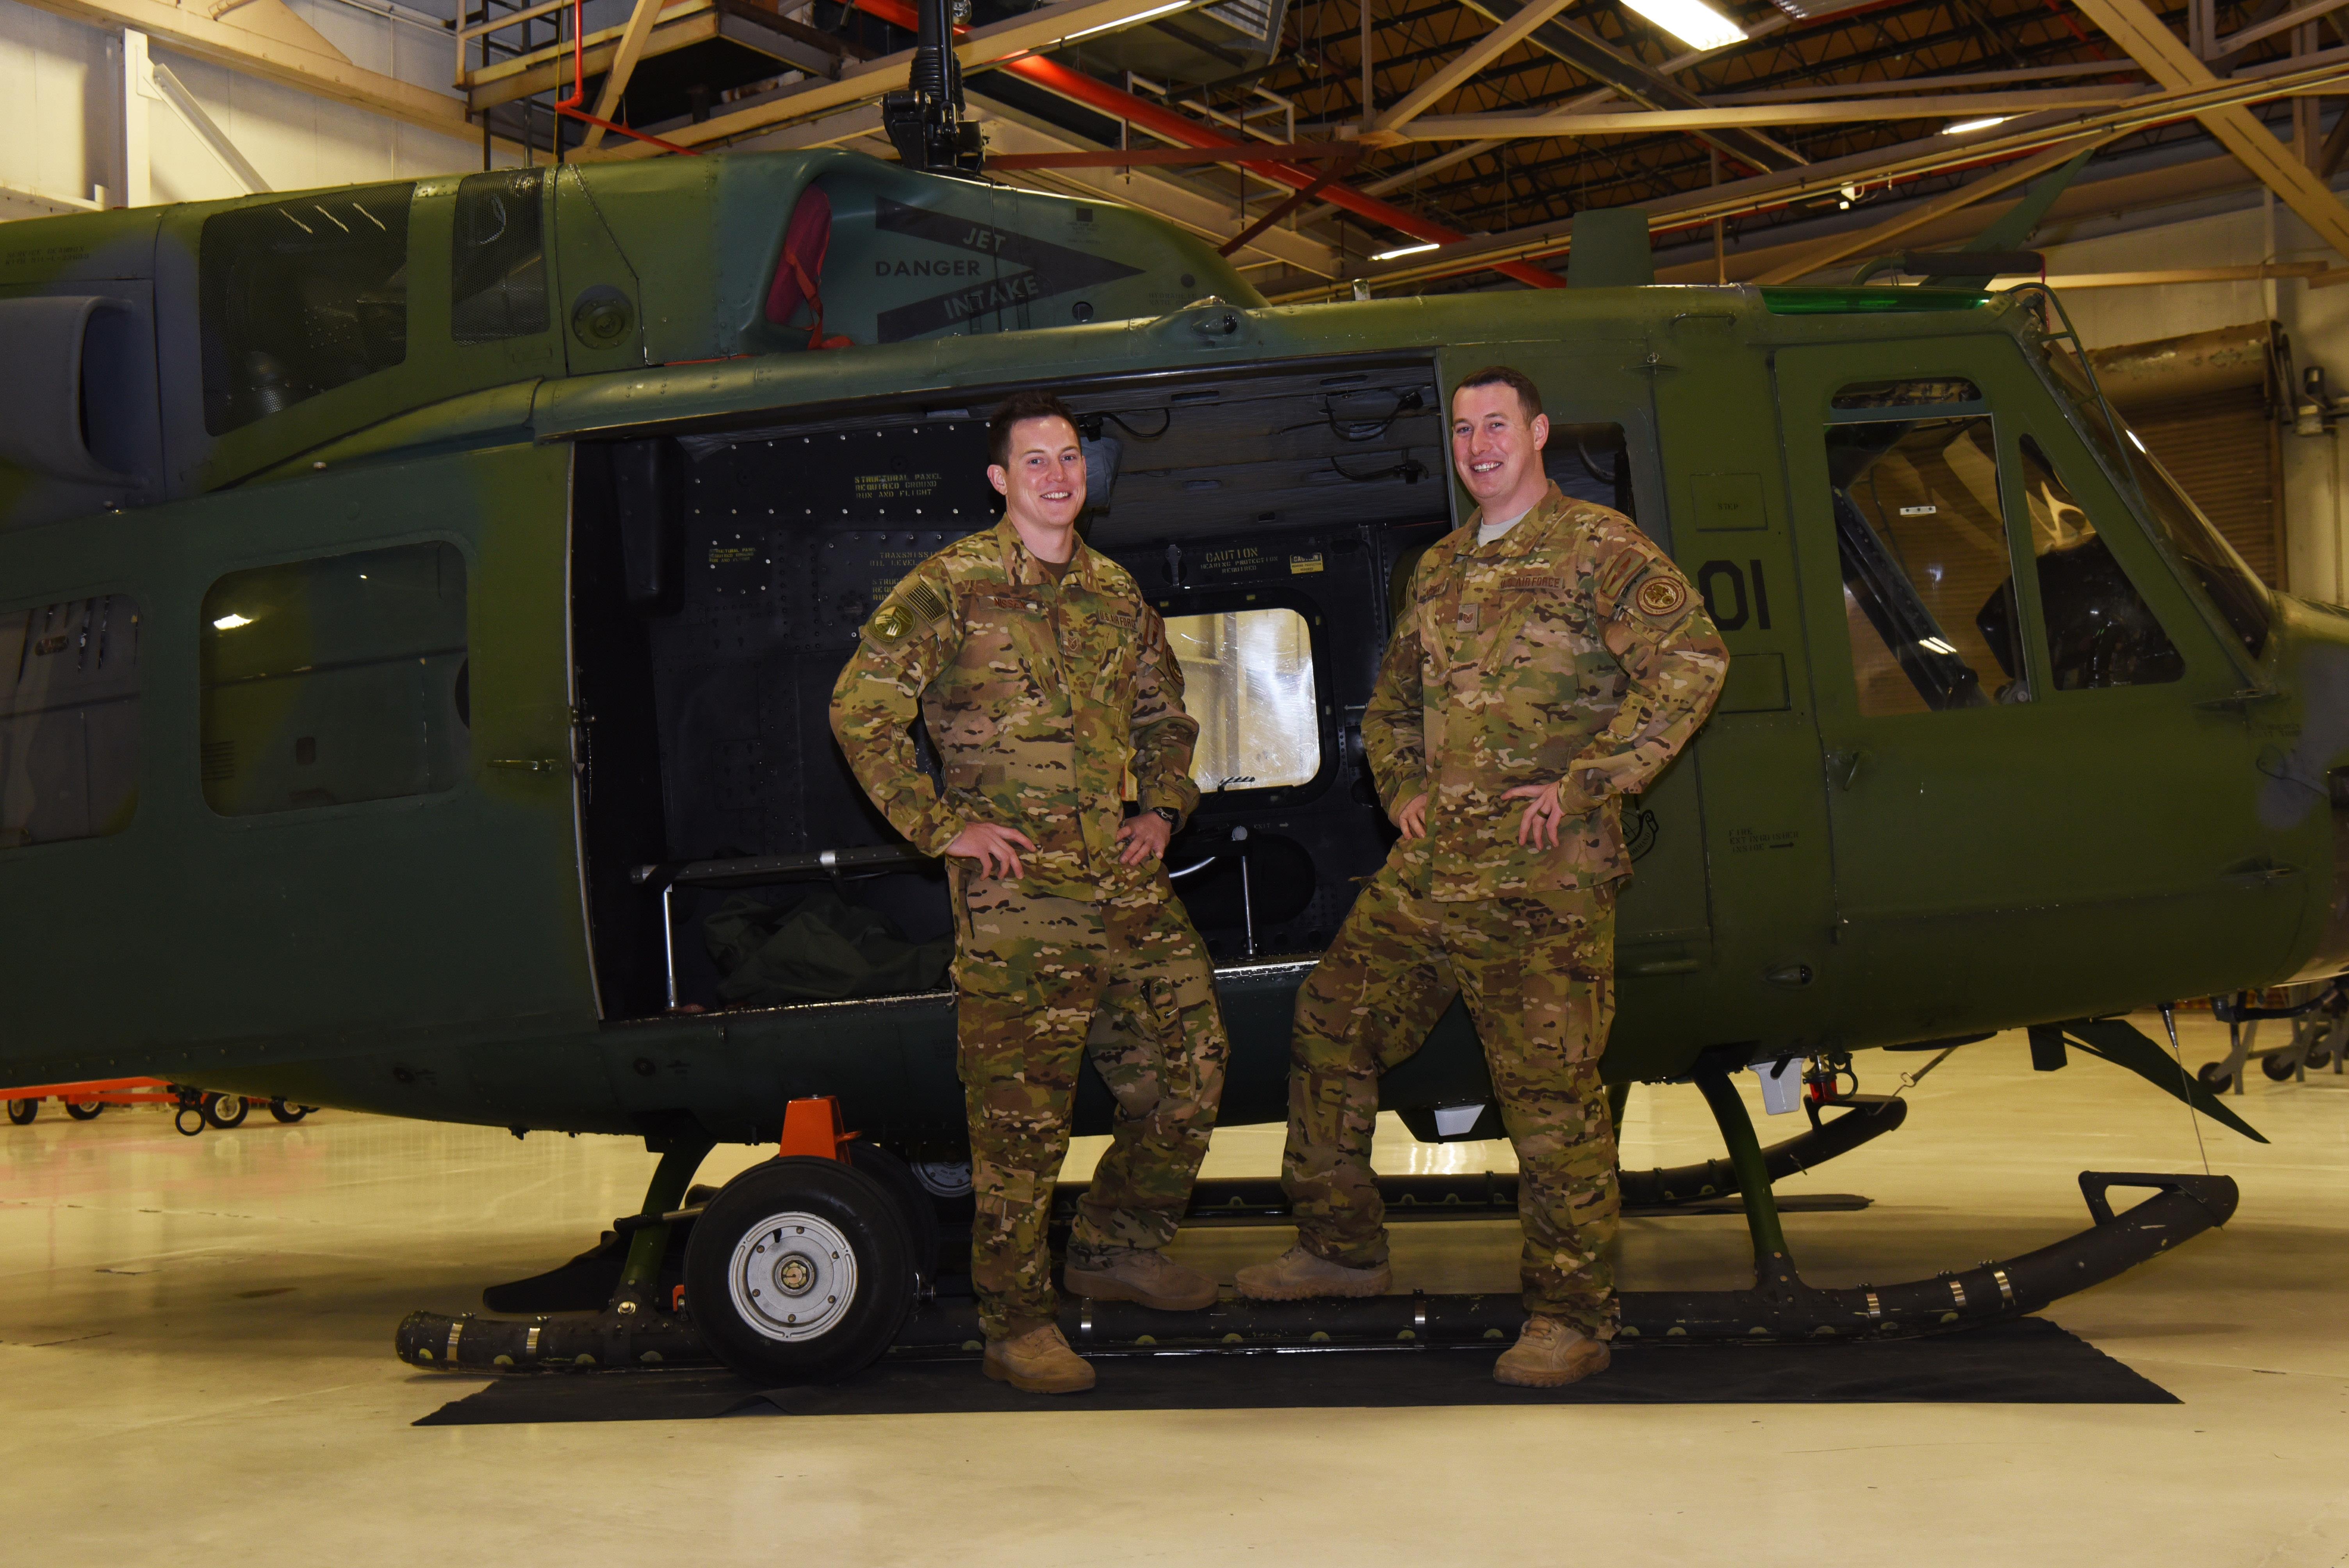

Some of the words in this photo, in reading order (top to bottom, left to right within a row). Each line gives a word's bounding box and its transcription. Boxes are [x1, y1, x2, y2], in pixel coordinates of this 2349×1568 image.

[963, 227, 1006, 253] JET
[875, 260, 981, 276] DANGER
[943, 274, 1039, 319] INTAKE
[854, 474, 909, 483] STRUCTURAL
[855, 482, 900, 491] REQUIRED
[905, 480, 937, 488] GROUND
[900, 489, 932, 497] FLIGHT
[1206, 547, 1258, 563] CAUTION
[1200, 561, 1231, 569] HEARING
[1235, 556, 1278, 566] PROTECTION
[1222, 565, 1256, 574] REQUIRED
[1515, 577, 1530, 586] AIR
[1531, 577, 1560, 588] FORCE
[994, 597, 1028, 610] NISSEN
[1111, 614, 1119, 625] AIR
[1119, 617, 1136, 629] FORCE
[1729, 828, 1753, 837] FIRE
[1729, 831, 1799, 845] EXTINGUISHER
[1630, 832, 1651, 856] OMMAND
[1732, 843, 1764, 853] INSIDE
